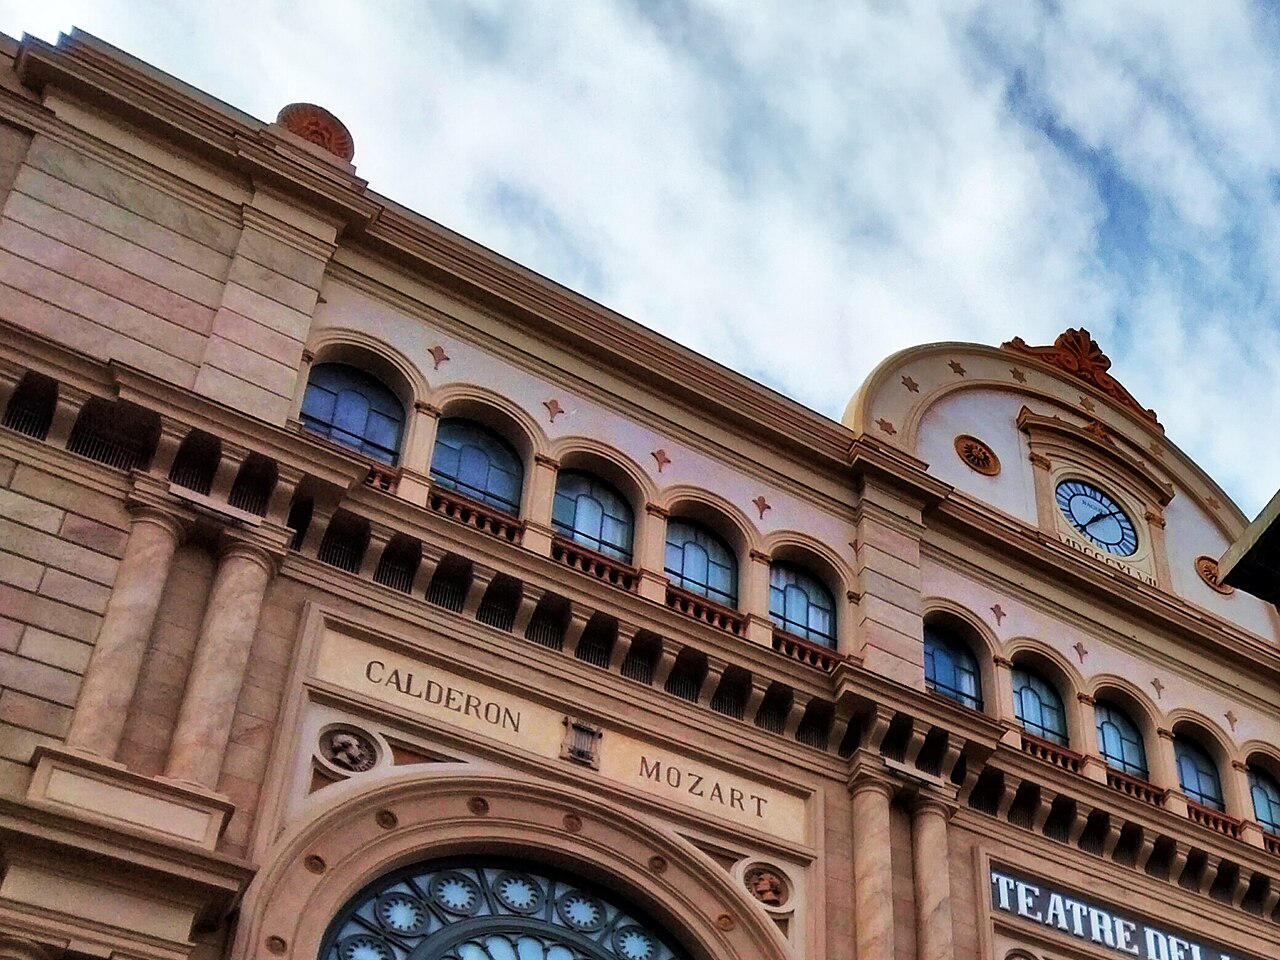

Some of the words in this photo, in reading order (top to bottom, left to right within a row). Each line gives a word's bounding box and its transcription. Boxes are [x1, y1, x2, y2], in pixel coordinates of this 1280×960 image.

[365, 659, 521, 733] CALDERON
[639, 755, 768, 818] MOZART
[991, 872, 1139, 956] TEATRE
